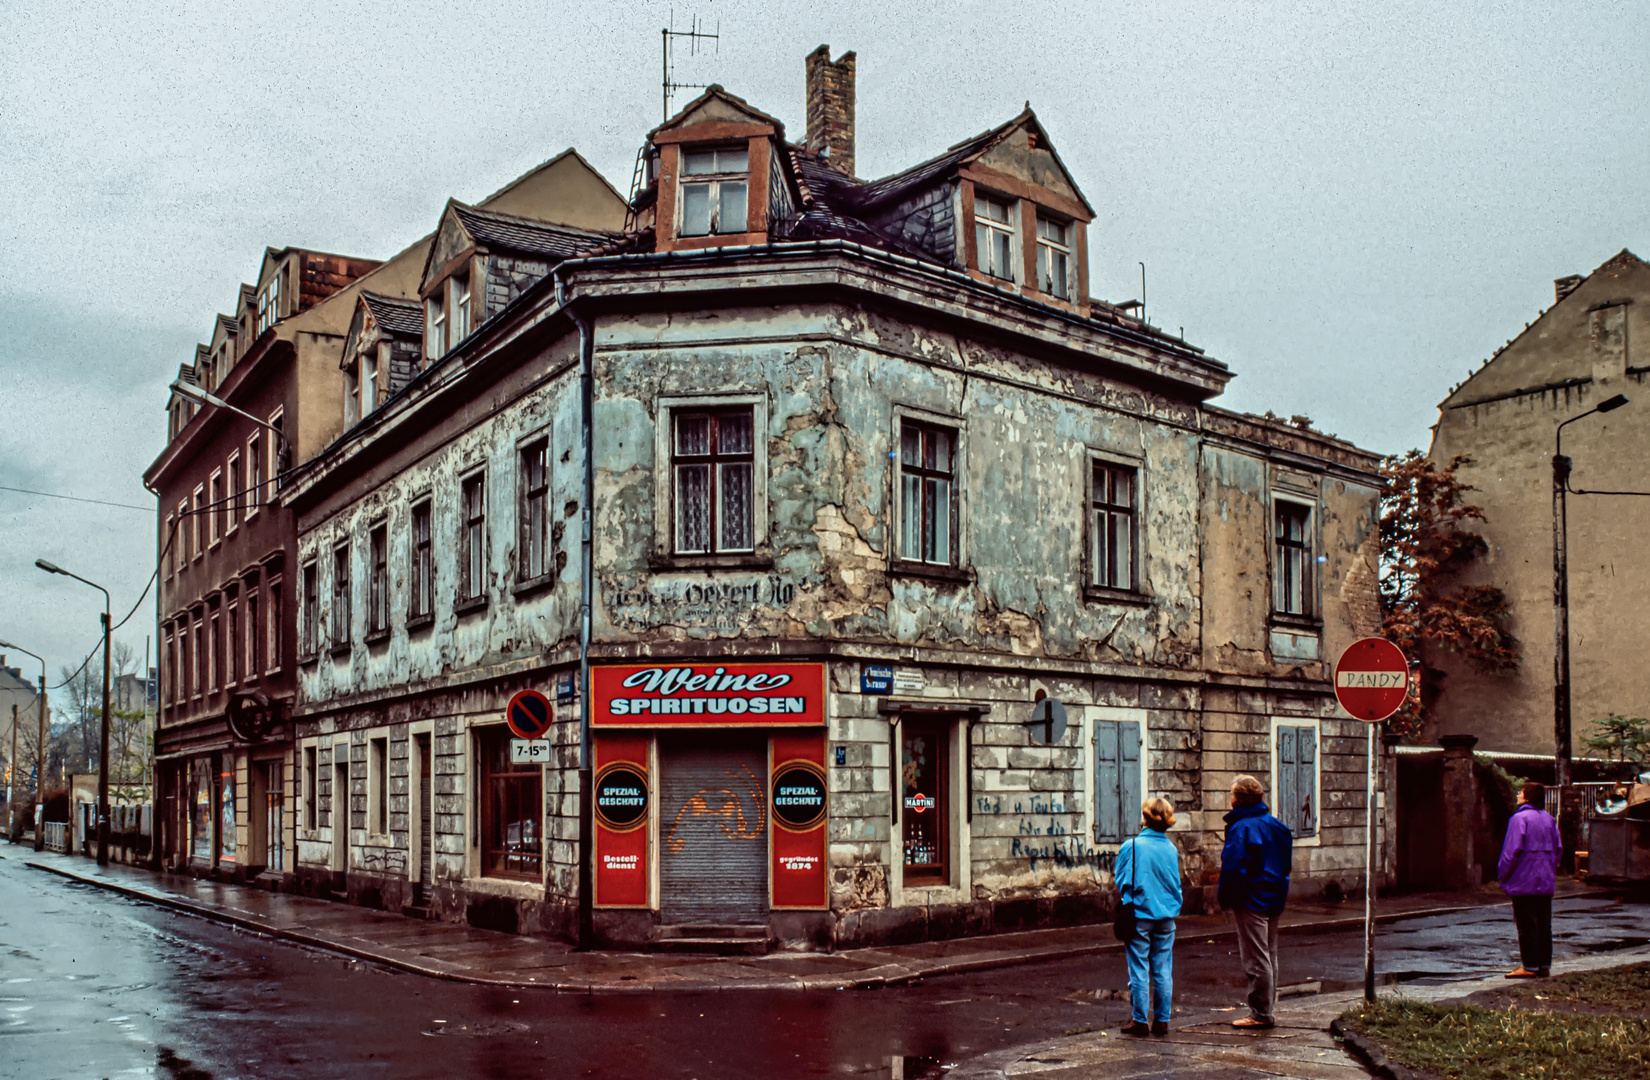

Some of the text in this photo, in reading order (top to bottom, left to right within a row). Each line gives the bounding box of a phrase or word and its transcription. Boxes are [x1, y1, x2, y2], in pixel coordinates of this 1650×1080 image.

[622, 667, 792, 696] Weine
[1347, 673, 1402, 687] DANDY
[610, 697, 805, 715] SPIRITUOSEN
[603, 787, 641, 796] SPEZIAL-
[780, 786, 818, 795] SPEZIAL-
[906, 799, 933, 807] MARTINI
